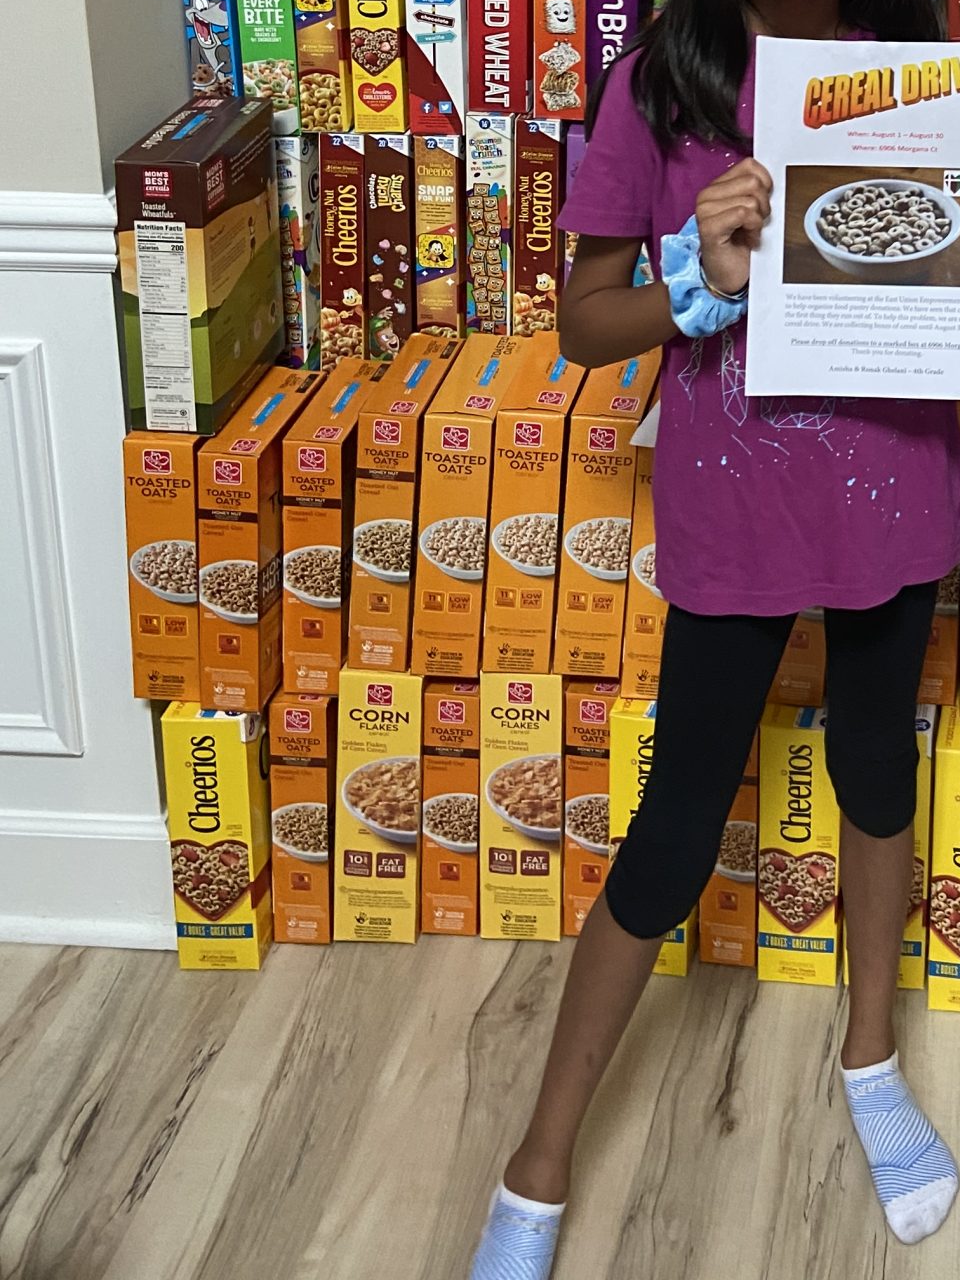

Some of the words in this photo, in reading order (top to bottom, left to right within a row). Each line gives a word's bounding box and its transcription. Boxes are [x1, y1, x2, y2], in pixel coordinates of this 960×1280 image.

[483, 32, 511, 108] WHEAT
[803, 67, 897, 129] CEREAL
[377, 177, 394, 212] Lucky
[392, 174, 406, 211] Charms
[126, 476, 192, 489] TOASTED
[141, 486, 178, 499] OATS
[349, 709, 410, 725] CORN
[360, 721, 400, 732] FLAKES
[188, 735, 218, 834] Cheerios
[781, 744, 813, 843] Cheerios
